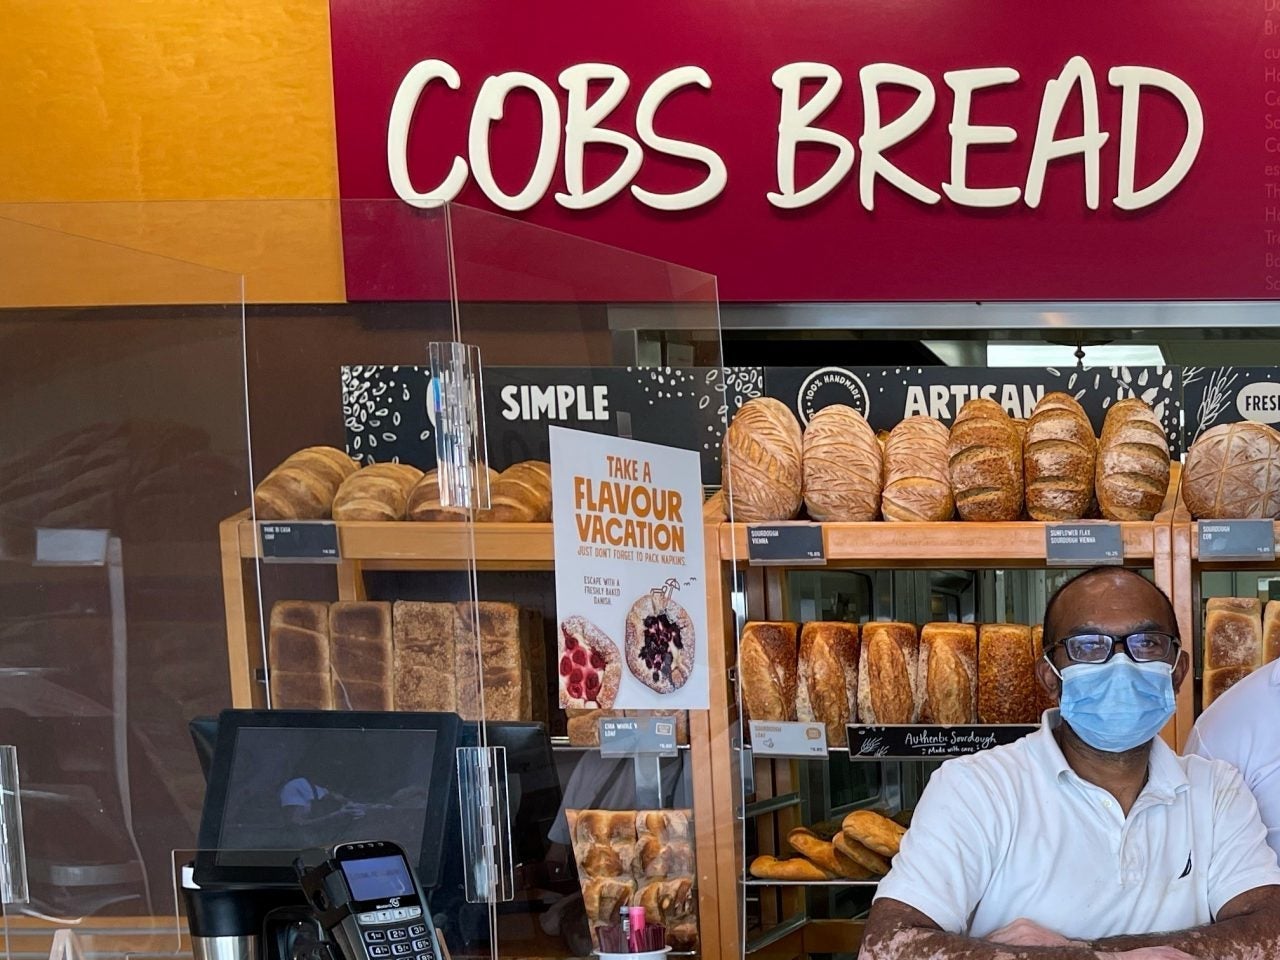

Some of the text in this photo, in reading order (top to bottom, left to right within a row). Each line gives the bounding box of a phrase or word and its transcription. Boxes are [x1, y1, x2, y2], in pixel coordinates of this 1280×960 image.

[388, 56, 1203, 210] COBS BREAD
[824, 374, 861, 399] HANDMADE
[500, 385, 609, 420] SIMPLE
[607, 456, 651, 483] TAKE A
[574, 476, 682, 522] FLAVOUR
[575, 514, 685, 552] VACATION
[578, 546, 592, 557] JUST
[595, 547, 611, 559] DON'T
[613, 549, 634, 560] FORGET
[636, 551, 643, 561] TO
[644, 552, 659, 563] PACK
[584, 586, 620, 597] FRESHLY BAKED
[928, 747, 945, 755] Made
[951, 731, 997, 749] Sourdough
